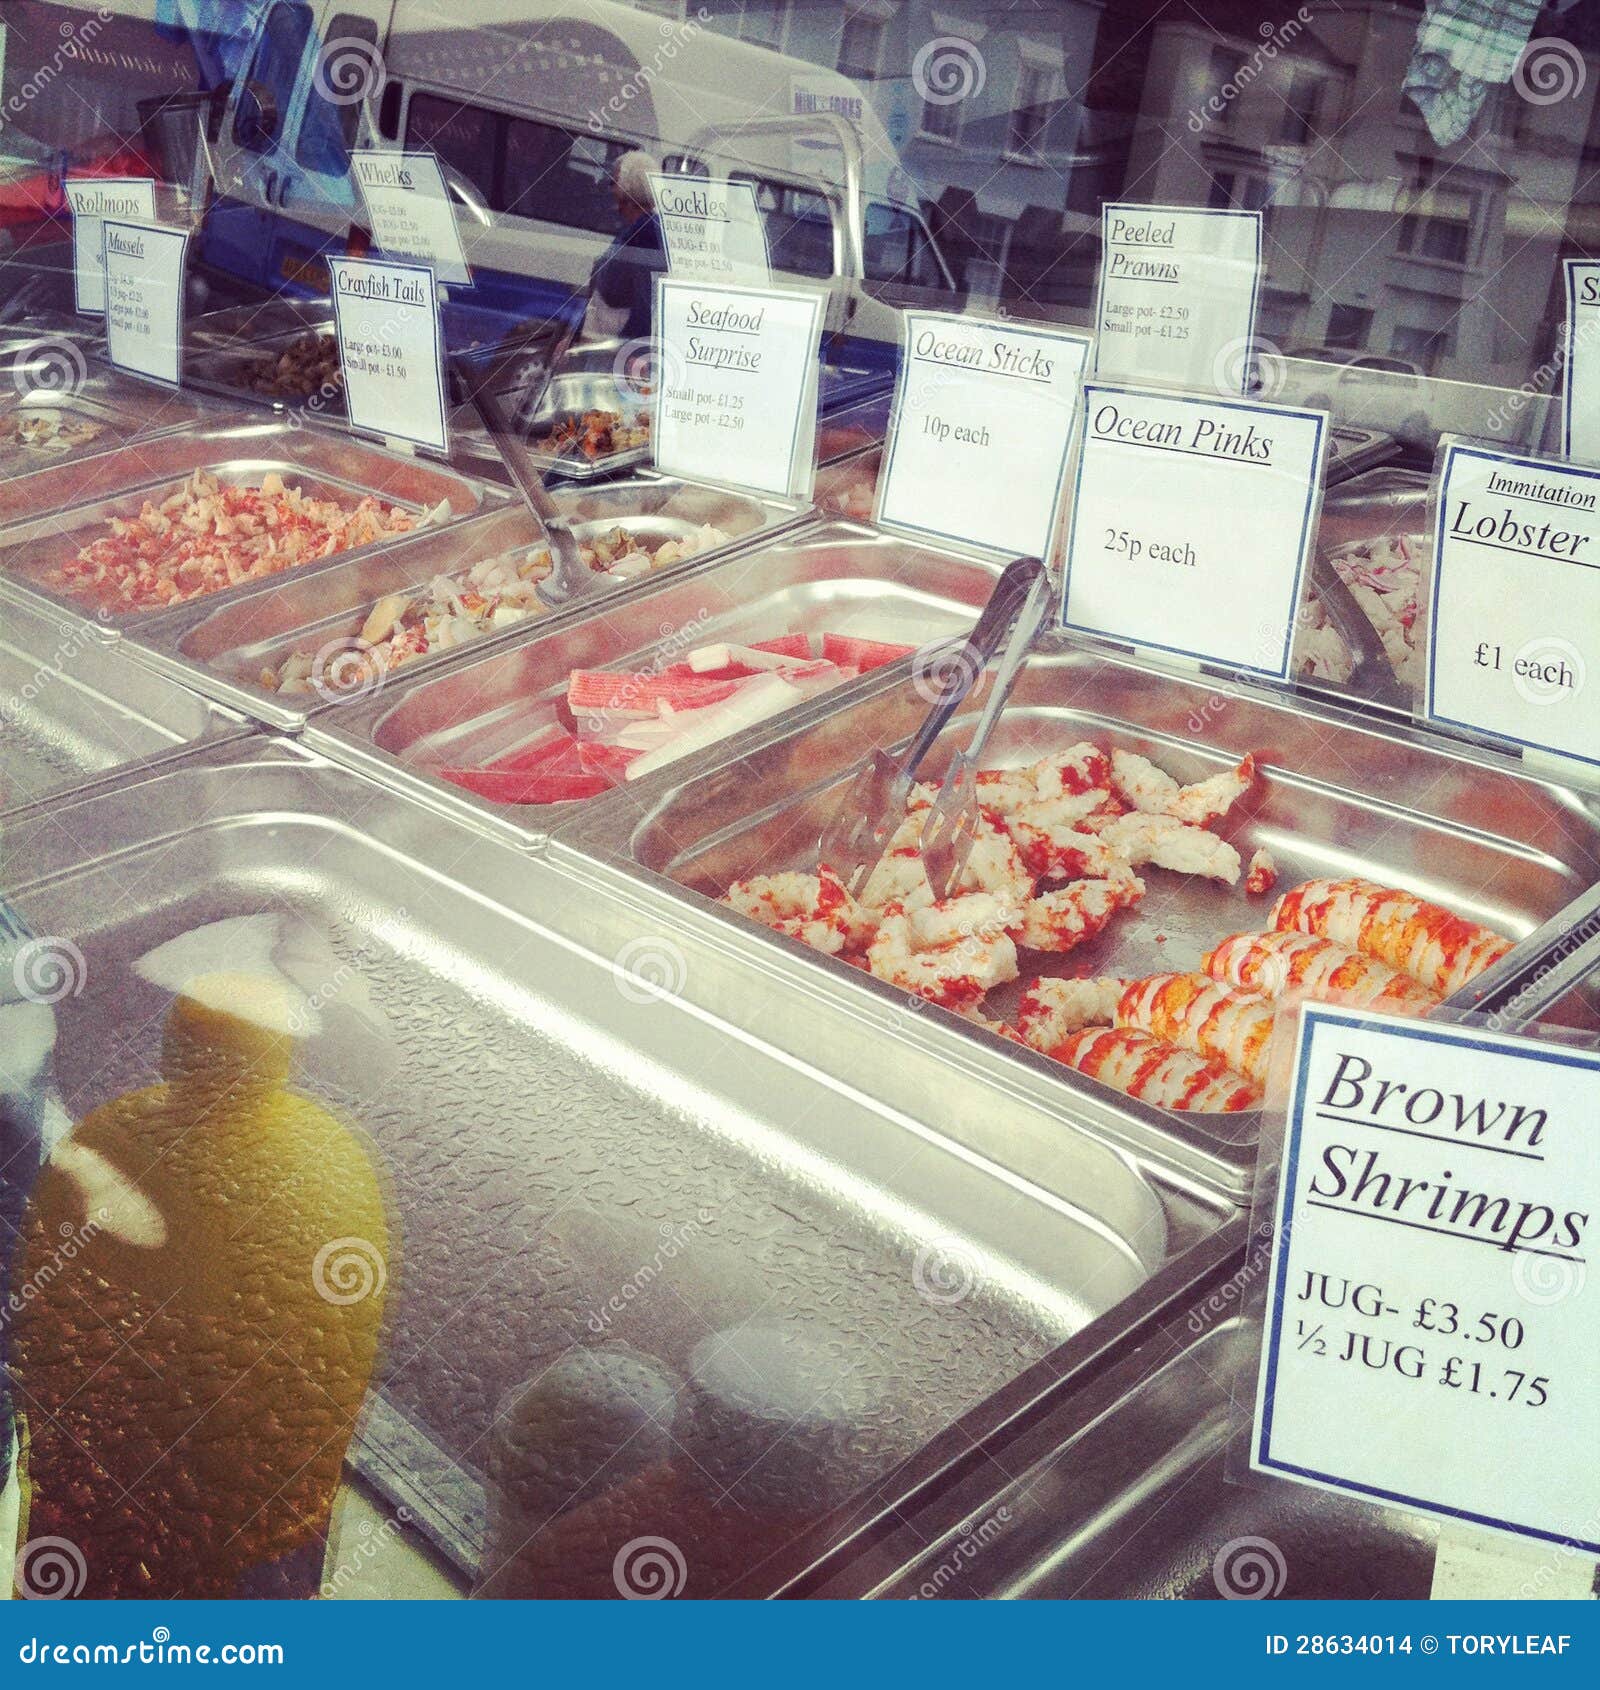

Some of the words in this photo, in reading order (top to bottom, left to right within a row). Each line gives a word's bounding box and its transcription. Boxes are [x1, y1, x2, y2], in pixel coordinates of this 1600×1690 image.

[360, 162, 413, 186] Whelks
[74, 192, 139, 215] Rollmops
[660, 188, 727, 217] Cockles
[108, 232, 145, 255] Mussels
[1111, 219, 1175, 244] Peeled
[1110, 253, 1180, 279] Prawns
[339, 270, 389, 299] Crayfish
[393, 278, 424, 303] Tails
[687, 301, 764, 331] Seafood
[1104, 319, 1132, 333] Small
[1106, 301, 1134, 318] Large
[1160, 306, 1189, 320] £2.50
[686, 337, 762, 368] Surprise
[916, 331, 984, 365] Ocean
[988, 343, 1055, 378] Sticks
[665, 386, 694, 402] Small
[717, 394, 744, 410] £1.25
[664, 405, 693, 423] Large
[694, 411, 710, 425] pot
[717, 413, 744, 430] £2.50
[922, 415, 950, 442] 10p
[954, 426, 990, 447] each
[1094, 405, 1182, 445] Ocean
[1191, 419, 1273, 460] Pinks
[1488, 471, 1597, 508] Immitation
[1450, 501, 1590, 557] Lobster
[1104, 528, 1142, 560] 25p
[1148, 543, 1196, 567] each
[1474, 642, 1503, 671] £1
[1514, 658, 1574, 689] each
[1317, 1053, 1549, 1147] Brown
[1308, 1144, 1590, 1253] Shrimps
[1298, 1270, 1399, 1319] JUG-
[1412, 1298, 1525, 1350] £3.50
[1339, 1331, 1427, 1378] JUG
[1439, 1356, 1550, 1407] £1.75
